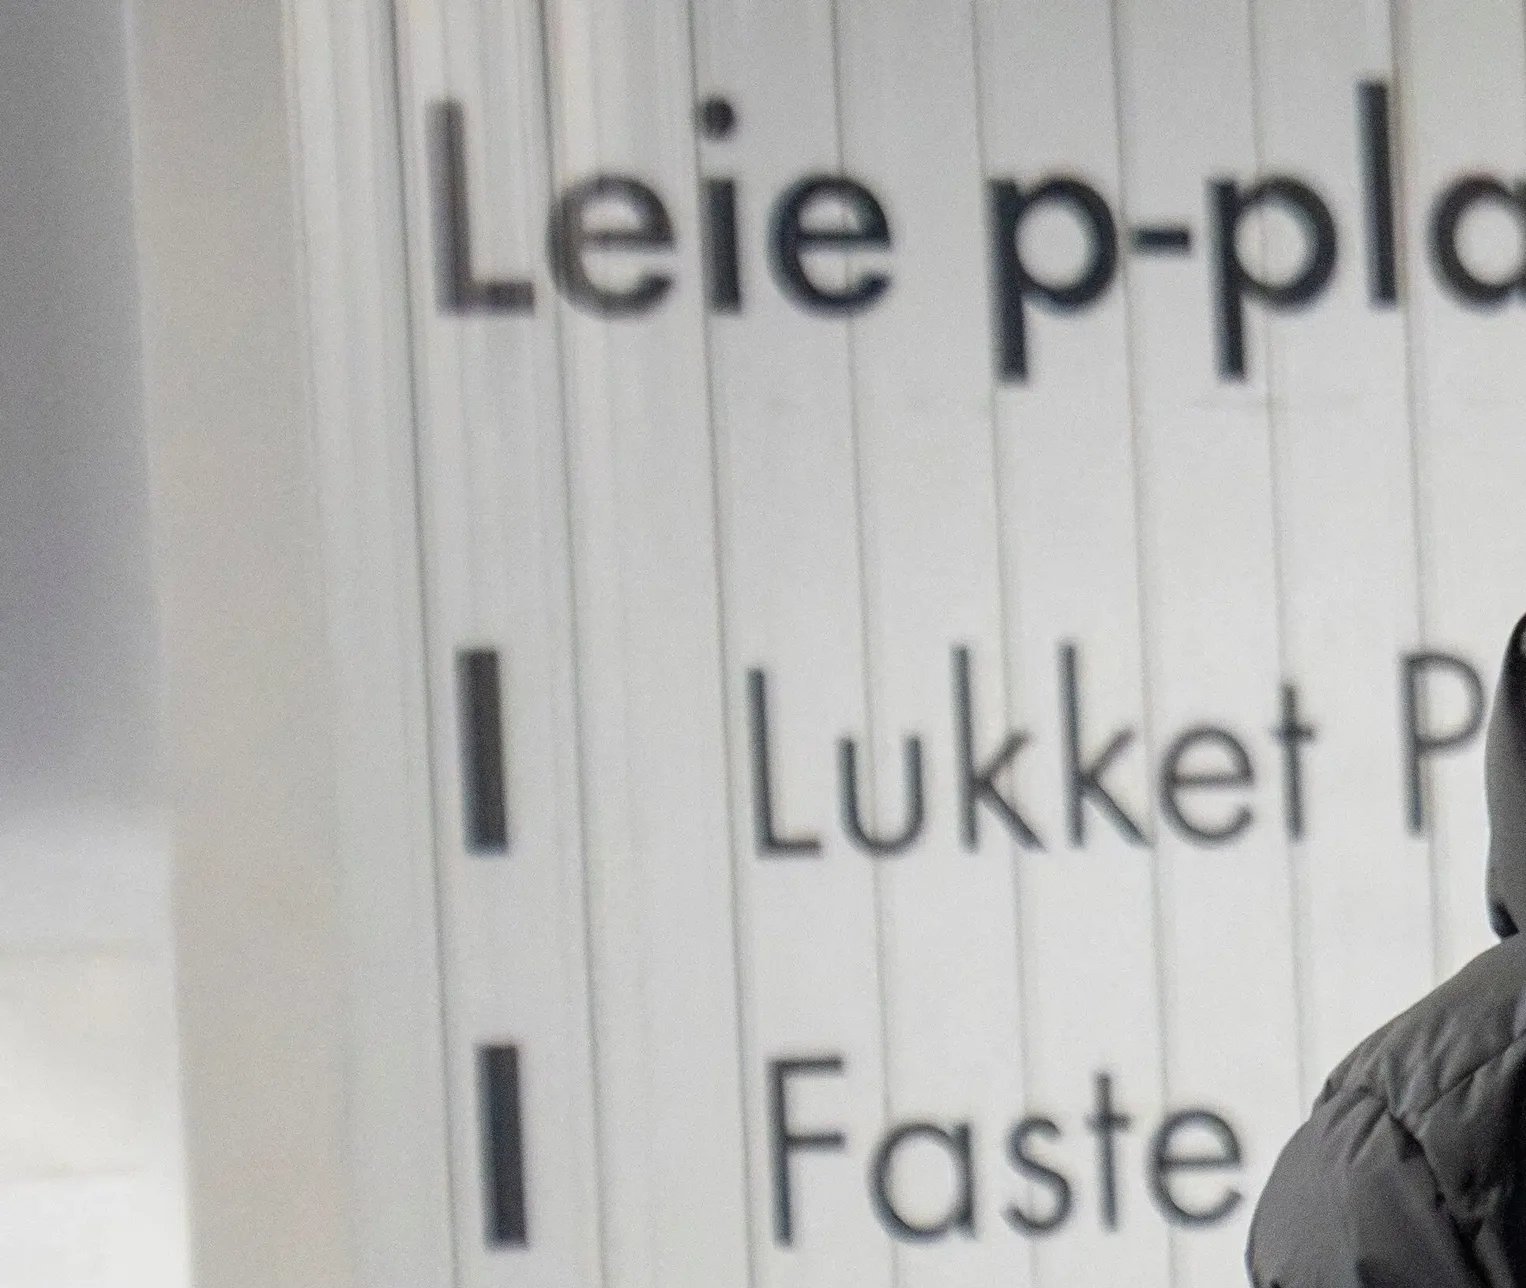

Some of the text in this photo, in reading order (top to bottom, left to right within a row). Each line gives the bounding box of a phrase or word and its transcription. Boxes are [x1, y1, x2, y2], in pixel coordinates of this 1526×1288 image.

[424, 95, 893, 319] Leie
[747, 638, 1319, 860] Lukket
[766, 1054, 1246, 1250] Faste
